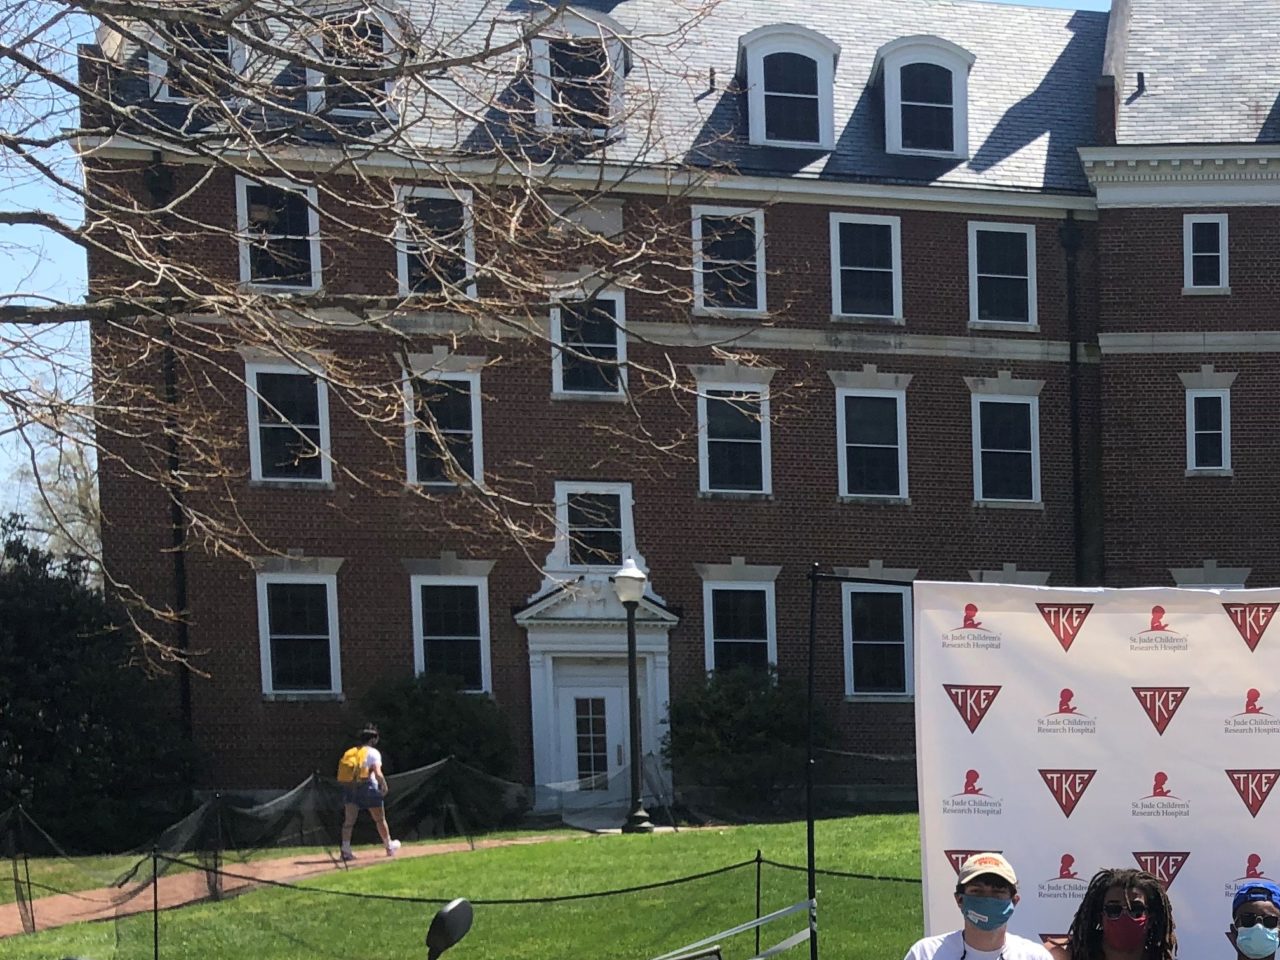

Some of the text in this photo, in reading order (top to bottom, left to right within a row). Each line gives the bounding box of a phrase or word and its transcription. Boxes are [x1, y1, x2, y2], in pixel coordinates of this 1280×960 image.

[1044, 608, 1086, 639] TKE
[1230, 607, 1272, 639] TKE
[1160, 644, 1188, 652] Hospital
[951, 689, 994, 721] TKE
[1140, 691, 1182, 723] TKE
[1046, 718, 1061, 726] Jude
[1068, 727, 1096, 735] Hospital
[1046, 774, 1089, 806] TKE
[1233, 774, 1276, 806] TKE
[1162, 809, 1190, 818] Hospital
[1141, 856, 1182, 883] TKE
